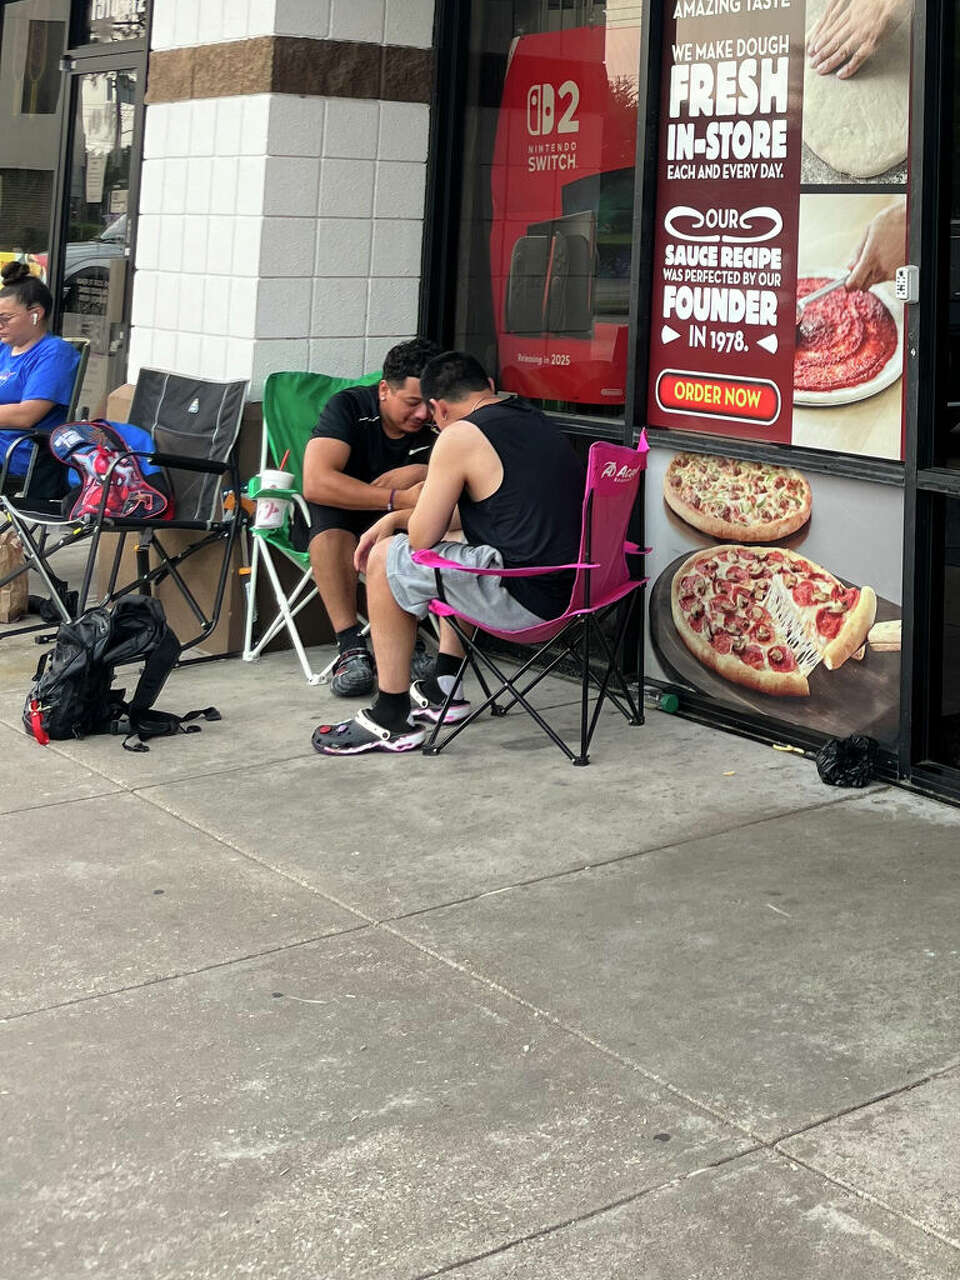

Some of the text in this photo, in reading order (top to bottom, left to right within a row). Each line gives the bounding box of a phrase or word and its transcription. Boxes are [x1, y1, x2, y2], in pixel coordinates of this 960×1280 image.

[672, 34, 790, 62] WE MAKE DOUGH
[669, 57, 790, 119] FRESH
[527, 141, 577, 154] NINTENDO
[667, 120, 787, 161] IN-STORE
[527, 153, 577, 173] SWITCH
[667, 163, 784, 180] EACH AND EVERY DAY.
[705, 208, 739, 230] OUR
[664, 245, 782, 270] SAUCE RECIPE
[663, 268, 781, 287] WAS PERFECTED BY OUR
[662, 285, 778, 326] FOUNDER
[689, 324, 749, 354] IN 1978.
[551, 353, 571, 366] 2025
[674, 381, 761, 410] ORDER NOW
